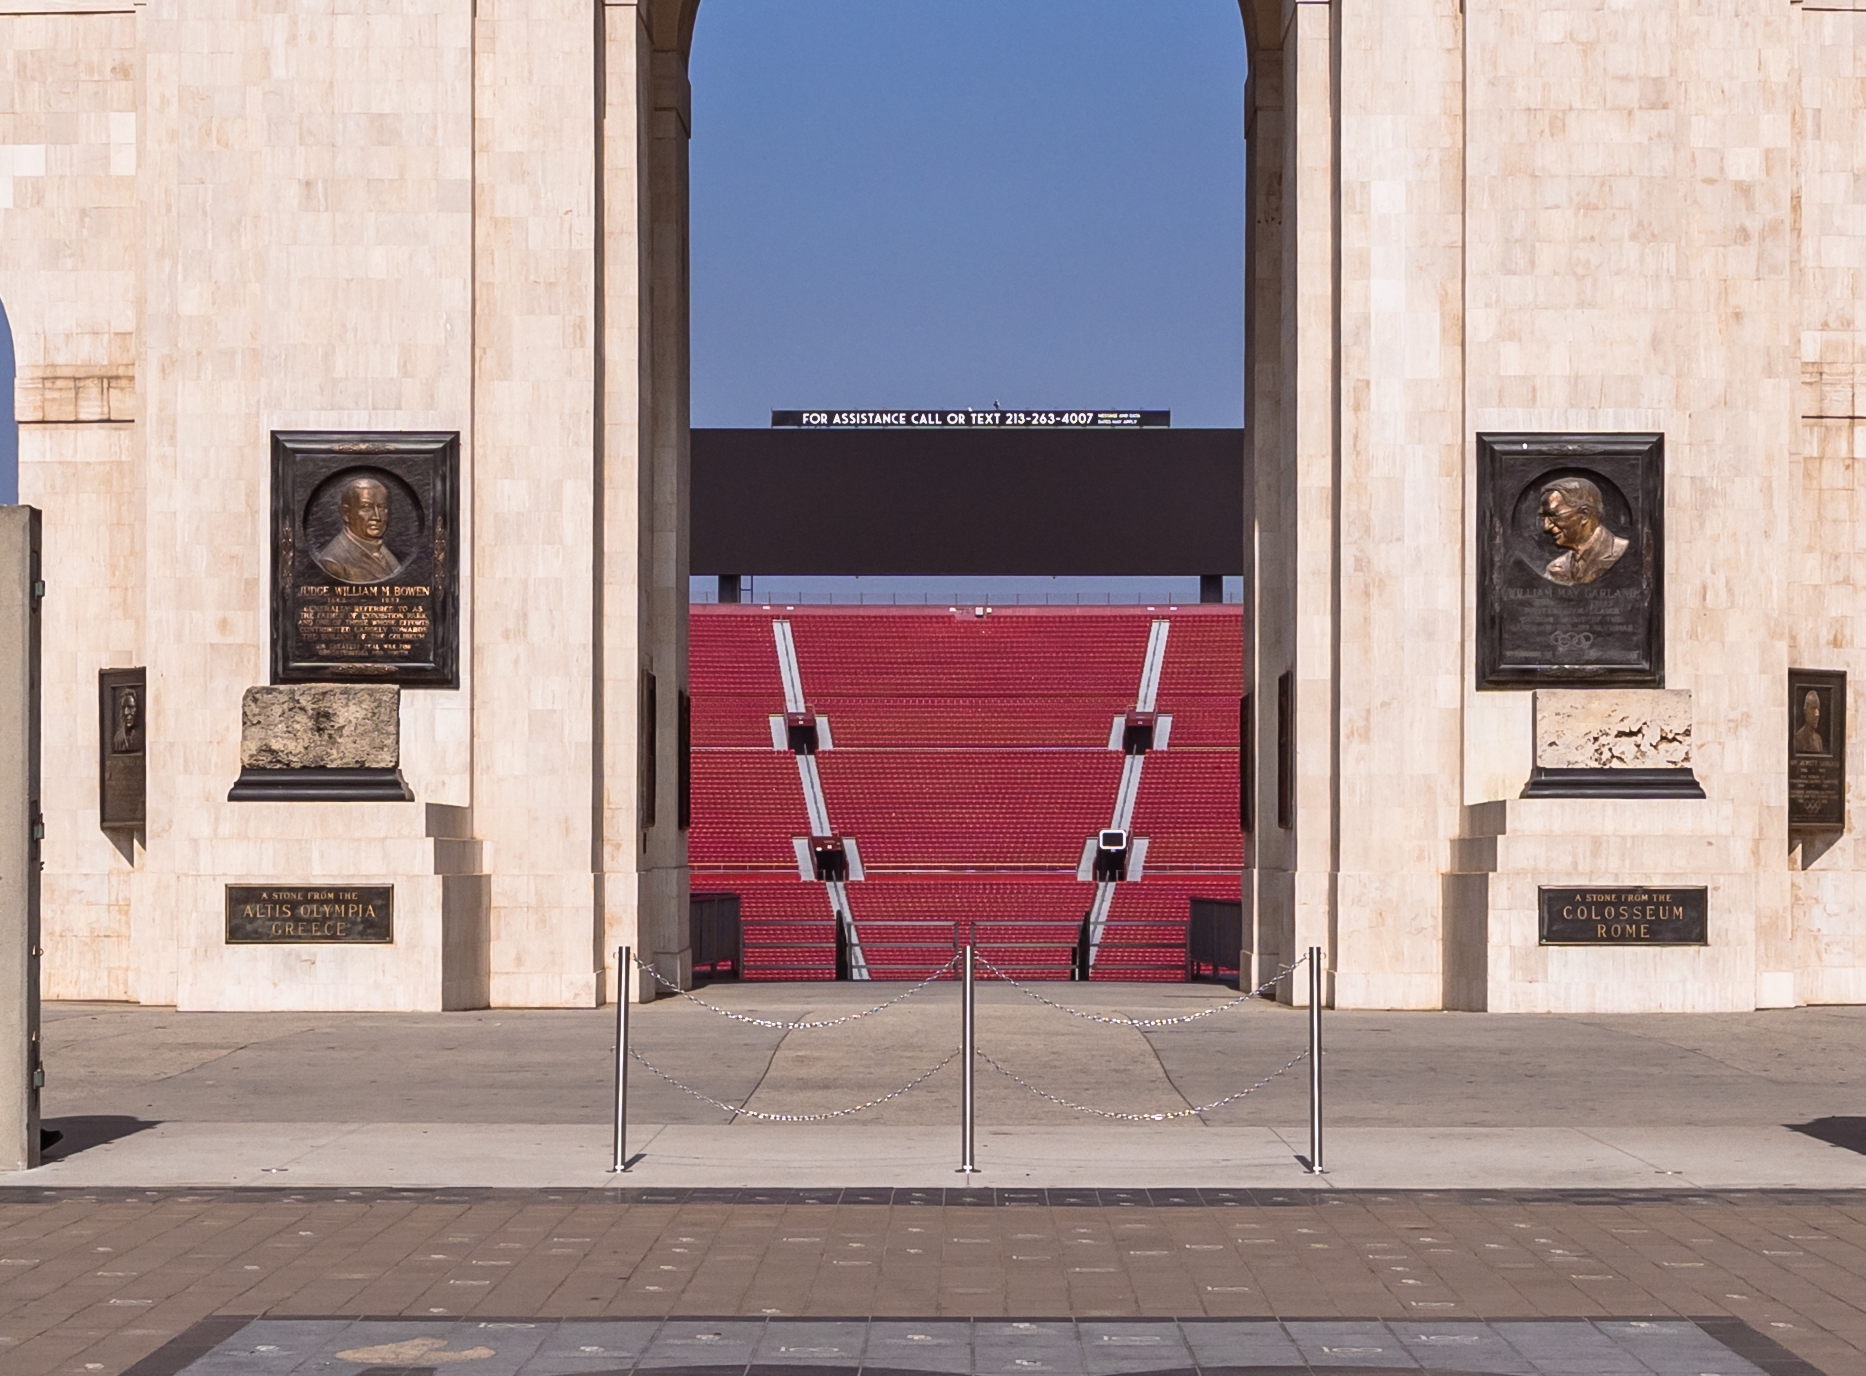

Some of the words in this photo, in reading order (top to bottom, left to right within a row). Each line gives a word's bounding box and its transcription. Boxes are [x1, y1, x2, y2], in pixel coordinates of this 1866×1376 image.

[802, 412, 828, 425] FOR
[832, 412, 907, 425] ASSISTANCE
[911, 412, 943, 425] CALL
[946, 412, 966, 425] OR
[970, 412, 1001, 425] TEXT
[1005, 412, 1094, 425] 213-263-4007
[297, 586, 330, 596] JUDGE
[334, 586, 378, 596] WILLIAM
[394, 586, 430, 596] BOWEN
[1507, 588, 1553, 598] WILLIAM
[1557, 588, 1580, 598] MAY
[1584, 588, 1636, 598] GARLAND
[261, 892, 268, 900] A
[272, 892, 303, 900] STONE
[308, 892, 335, 900] FROM
[339, 892, 358, 900] THE
[1575, 894, 1582, 902] A
[1586, 894, 1618, 902] STONE
[1621, 894, 1649, 902] FROM
[1652, 894, 1672, 902] THE
[243, 905, 292, 918] ALTIS
[300, 905, 377, 918] OLYMPIA
[1563, 906, 1684, 920] COLOSSEUM
[271, 922, 347, 936] GREECE
[1597, 924, 1650, 938] ROME
